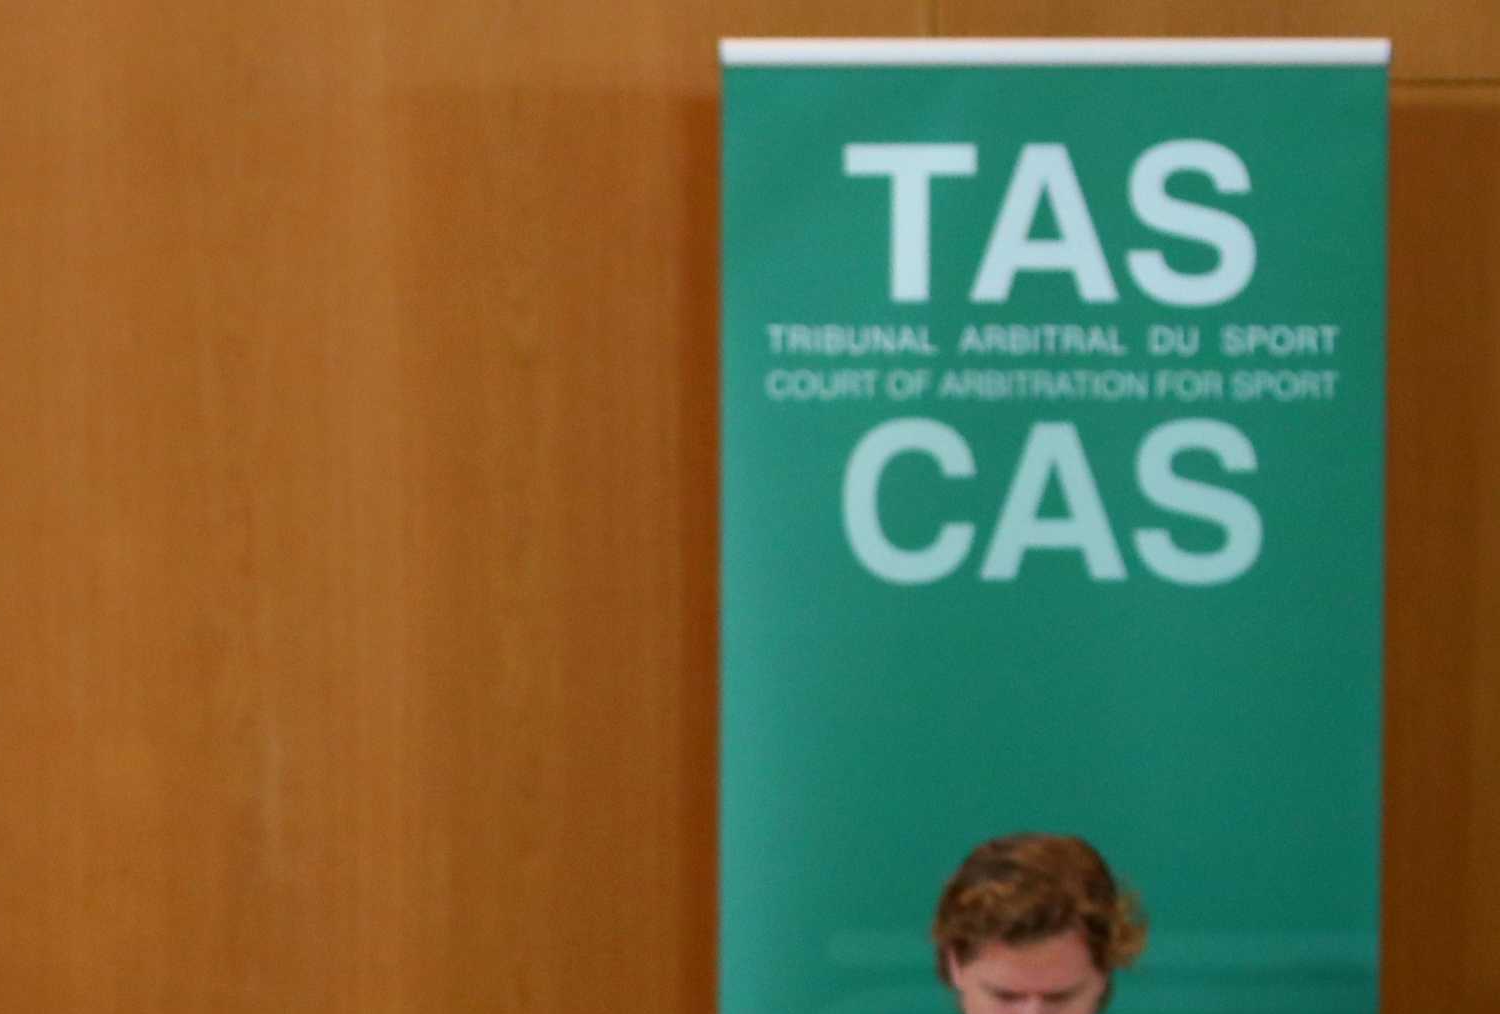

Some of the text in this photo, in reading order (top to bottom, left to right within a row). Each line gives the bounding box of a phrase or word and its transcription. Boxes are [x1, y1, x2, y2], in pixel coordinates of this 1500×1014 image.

[843, 138, 1258, 307] TAS
[764, 367, 1338, 402] COURT OF ARBITRATION FOR SPORT
[766, 323, 1339, 358] TRIBUNAL ARBITRAL DU SPORT
[841, 416, 1264, 586] CAS
